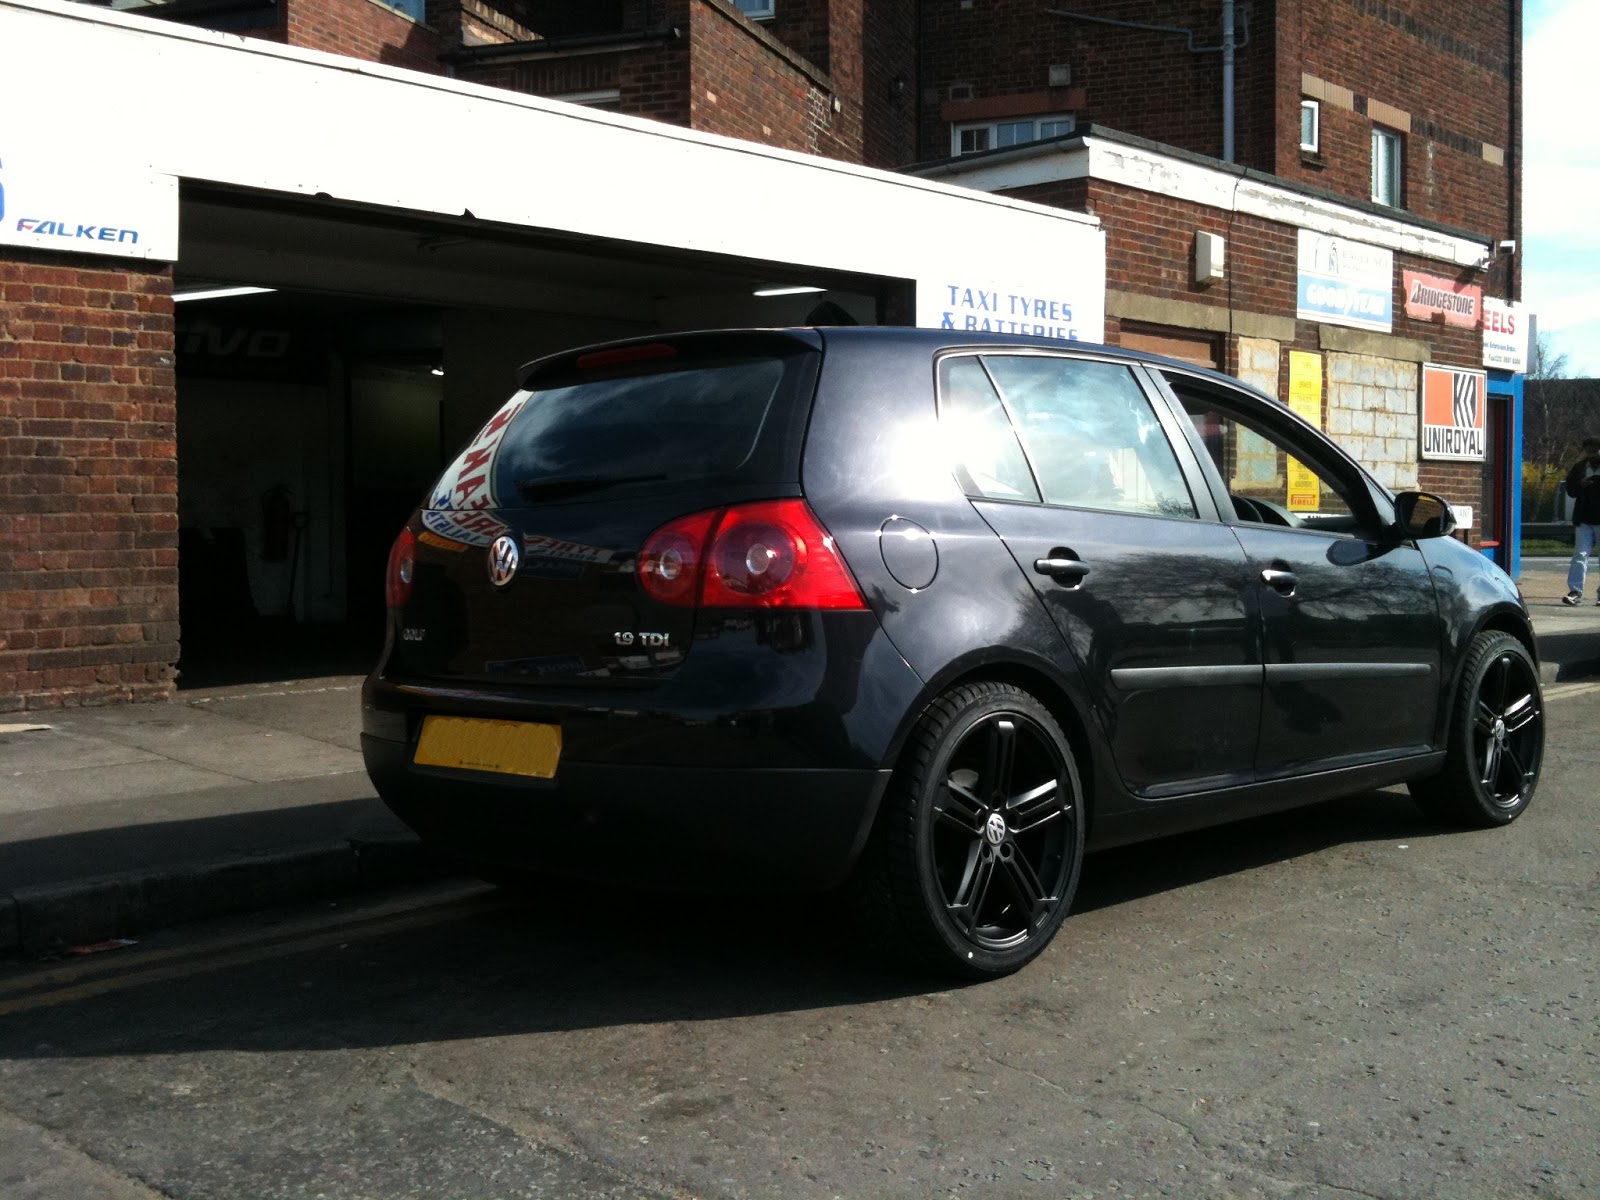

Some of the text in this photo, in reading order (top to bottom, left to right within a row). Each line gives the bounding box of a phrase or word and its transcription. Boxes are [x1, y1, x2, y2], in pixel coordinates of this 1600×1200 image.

[16, 217, 139, 244] FALKEN
[947, 284, 1073, 323] TAXI TYRES
[1410, 280, 1475, 315] BRIDGESTONE
[941, 311, 956, 330] &
[1423, 427, 1483, 455] UNIROYAL
[638, 631, 670, 647] TDI
